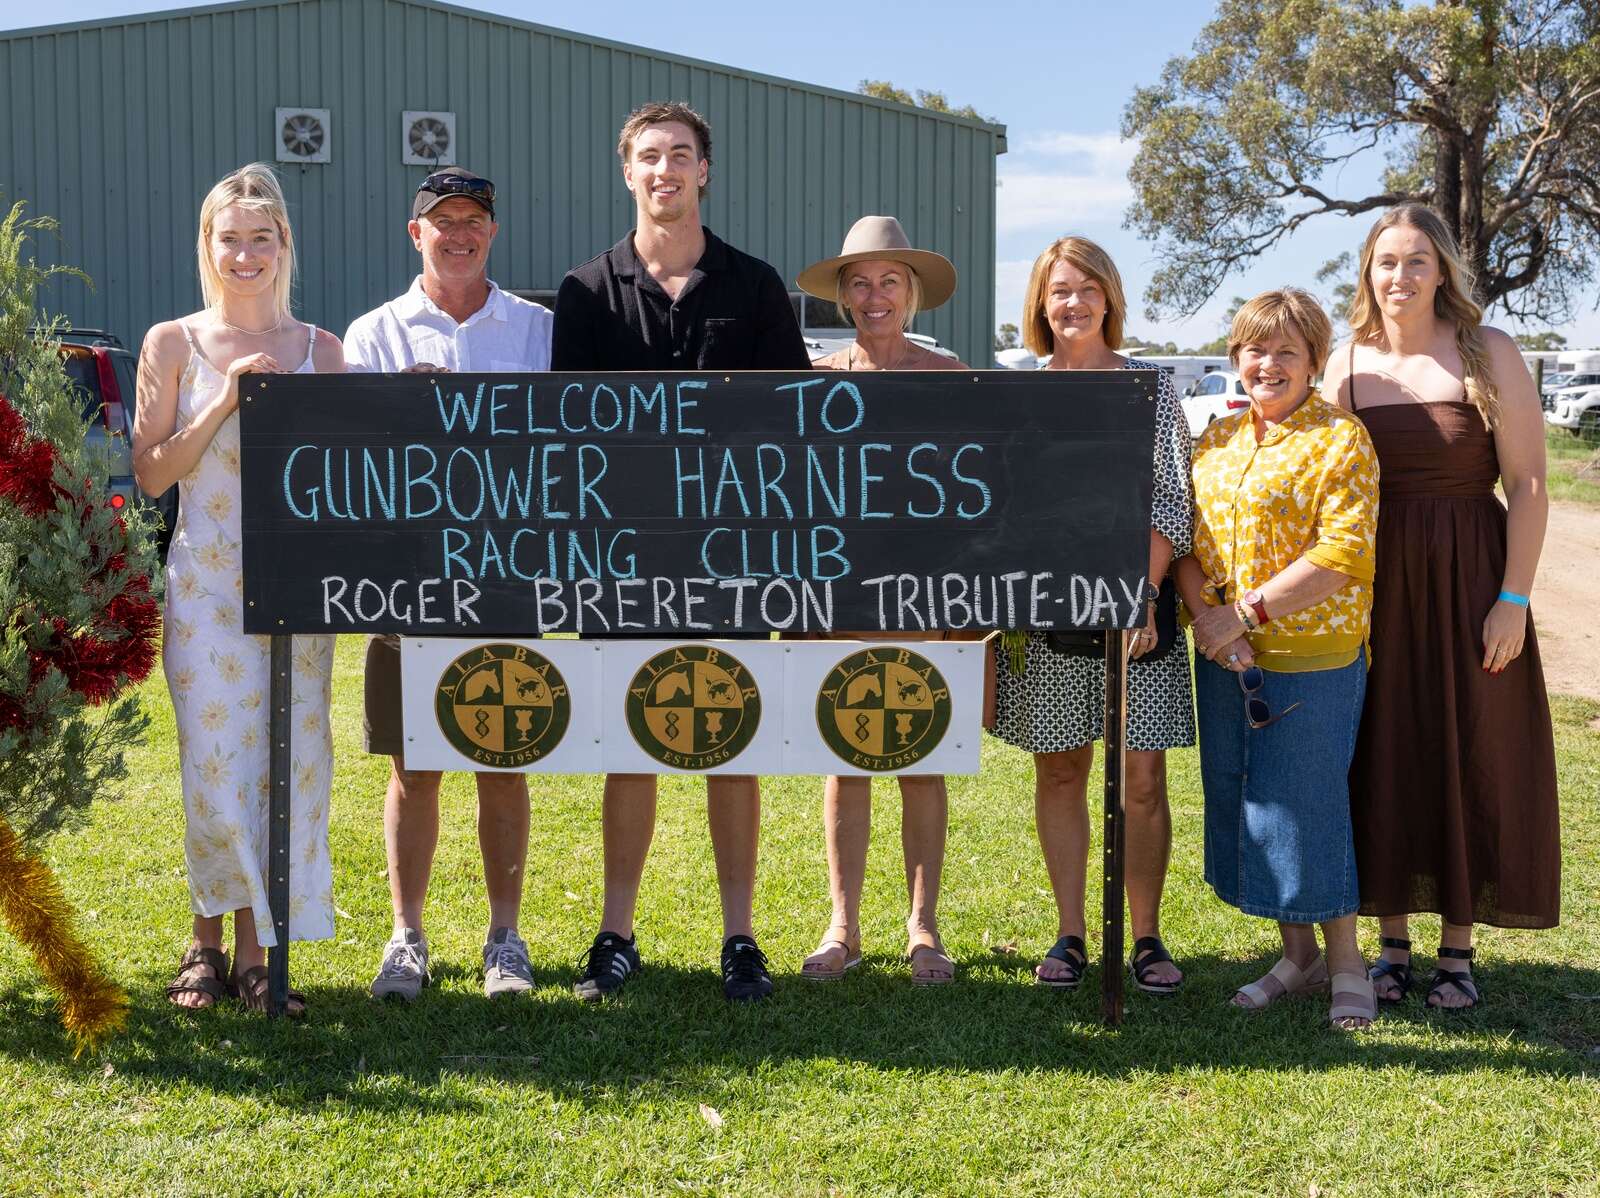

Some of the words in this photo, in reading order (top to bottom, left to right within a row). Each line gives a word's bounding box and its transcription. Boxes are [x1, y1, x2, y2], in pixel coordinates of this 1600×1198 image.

[435, 381, 710, 435] WELCOME
[775, 377, 866, 437] TO
[283, 443, 612, 522] GUNBOWER
[674, 442, 992, 521] HARNESS
[441, 528, 638, 582] RACING
[700, 524, 852, 581] CLUB
[321, 576, 483, 625] ROGER
[534, 575, 834, 633] BRERETON
[860, 570, 1147, 631] TRIBUTE-DAY
[440, 647, 567, 699] ALABAR
[631, 649, 757, 701] ALABAR
[821, 650, 949, 702] ALABAR
